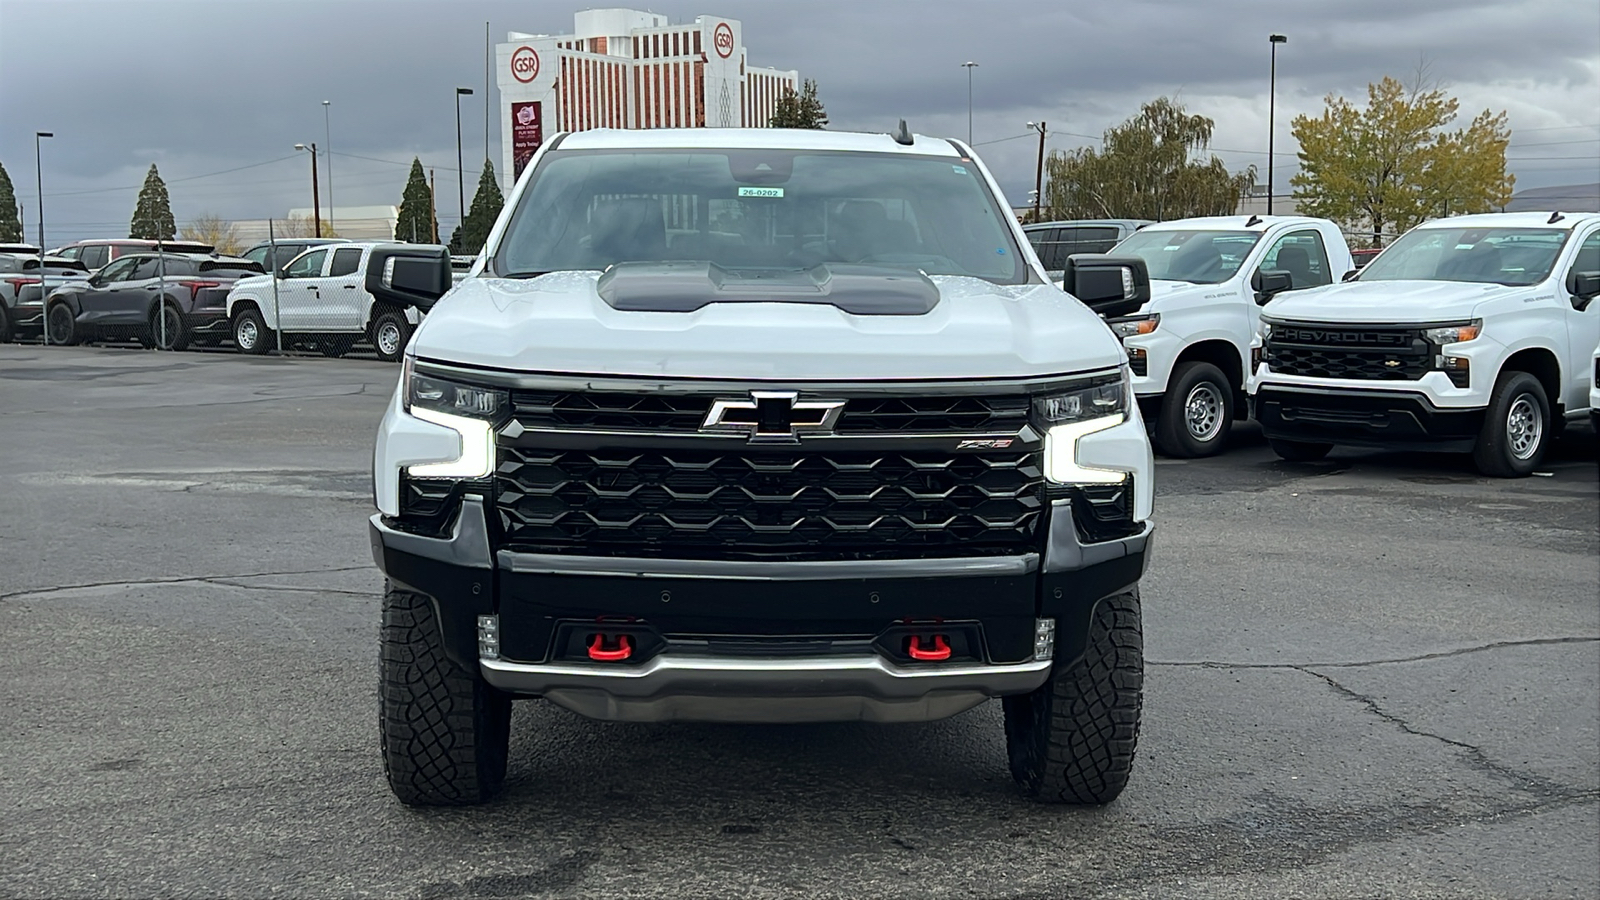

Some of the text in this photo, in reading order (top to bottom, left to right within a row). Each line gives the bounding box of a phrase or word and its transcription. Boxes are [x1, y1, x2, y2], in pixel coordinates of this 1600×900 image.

[717, 33, 731, 48] GSR
[515, 57, 535, 72] GSR
[1273, 328, 1411, 344] CHEVROLET
[956, 439, 1014, 450] ZR2
